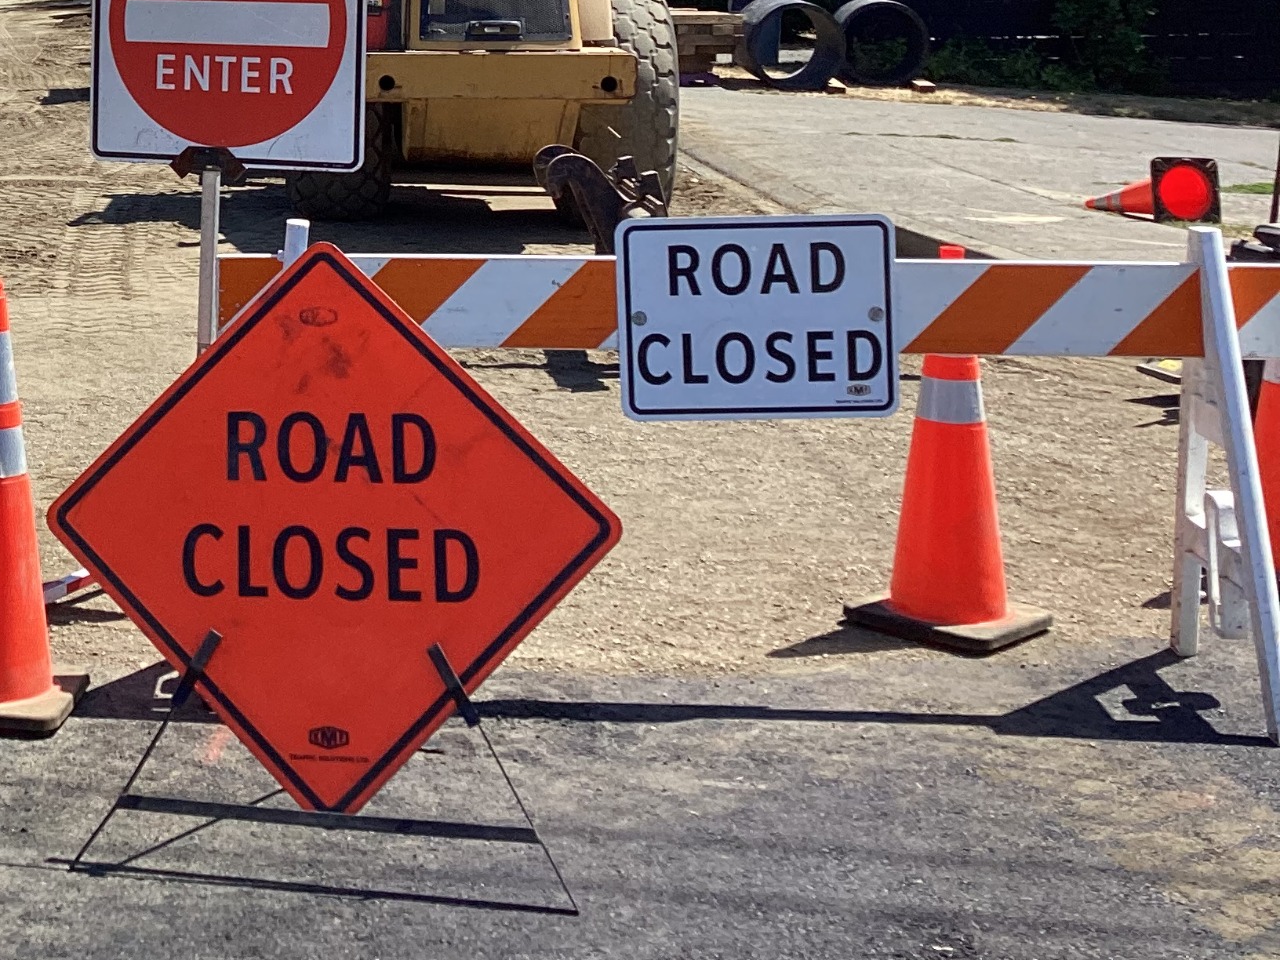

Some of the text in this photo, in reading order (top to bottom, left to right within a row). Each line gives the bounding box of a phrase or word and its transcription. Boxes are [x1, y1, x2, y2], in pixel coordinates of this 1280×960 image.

[156, 53, 294, 95] ENTER
[667, 241, 846, 297] ROAD
[637, 329, 883, 386] CLOSED
[226, 410, 437, 484] ROAD
[181, 523, 480, 603] CLOSED
